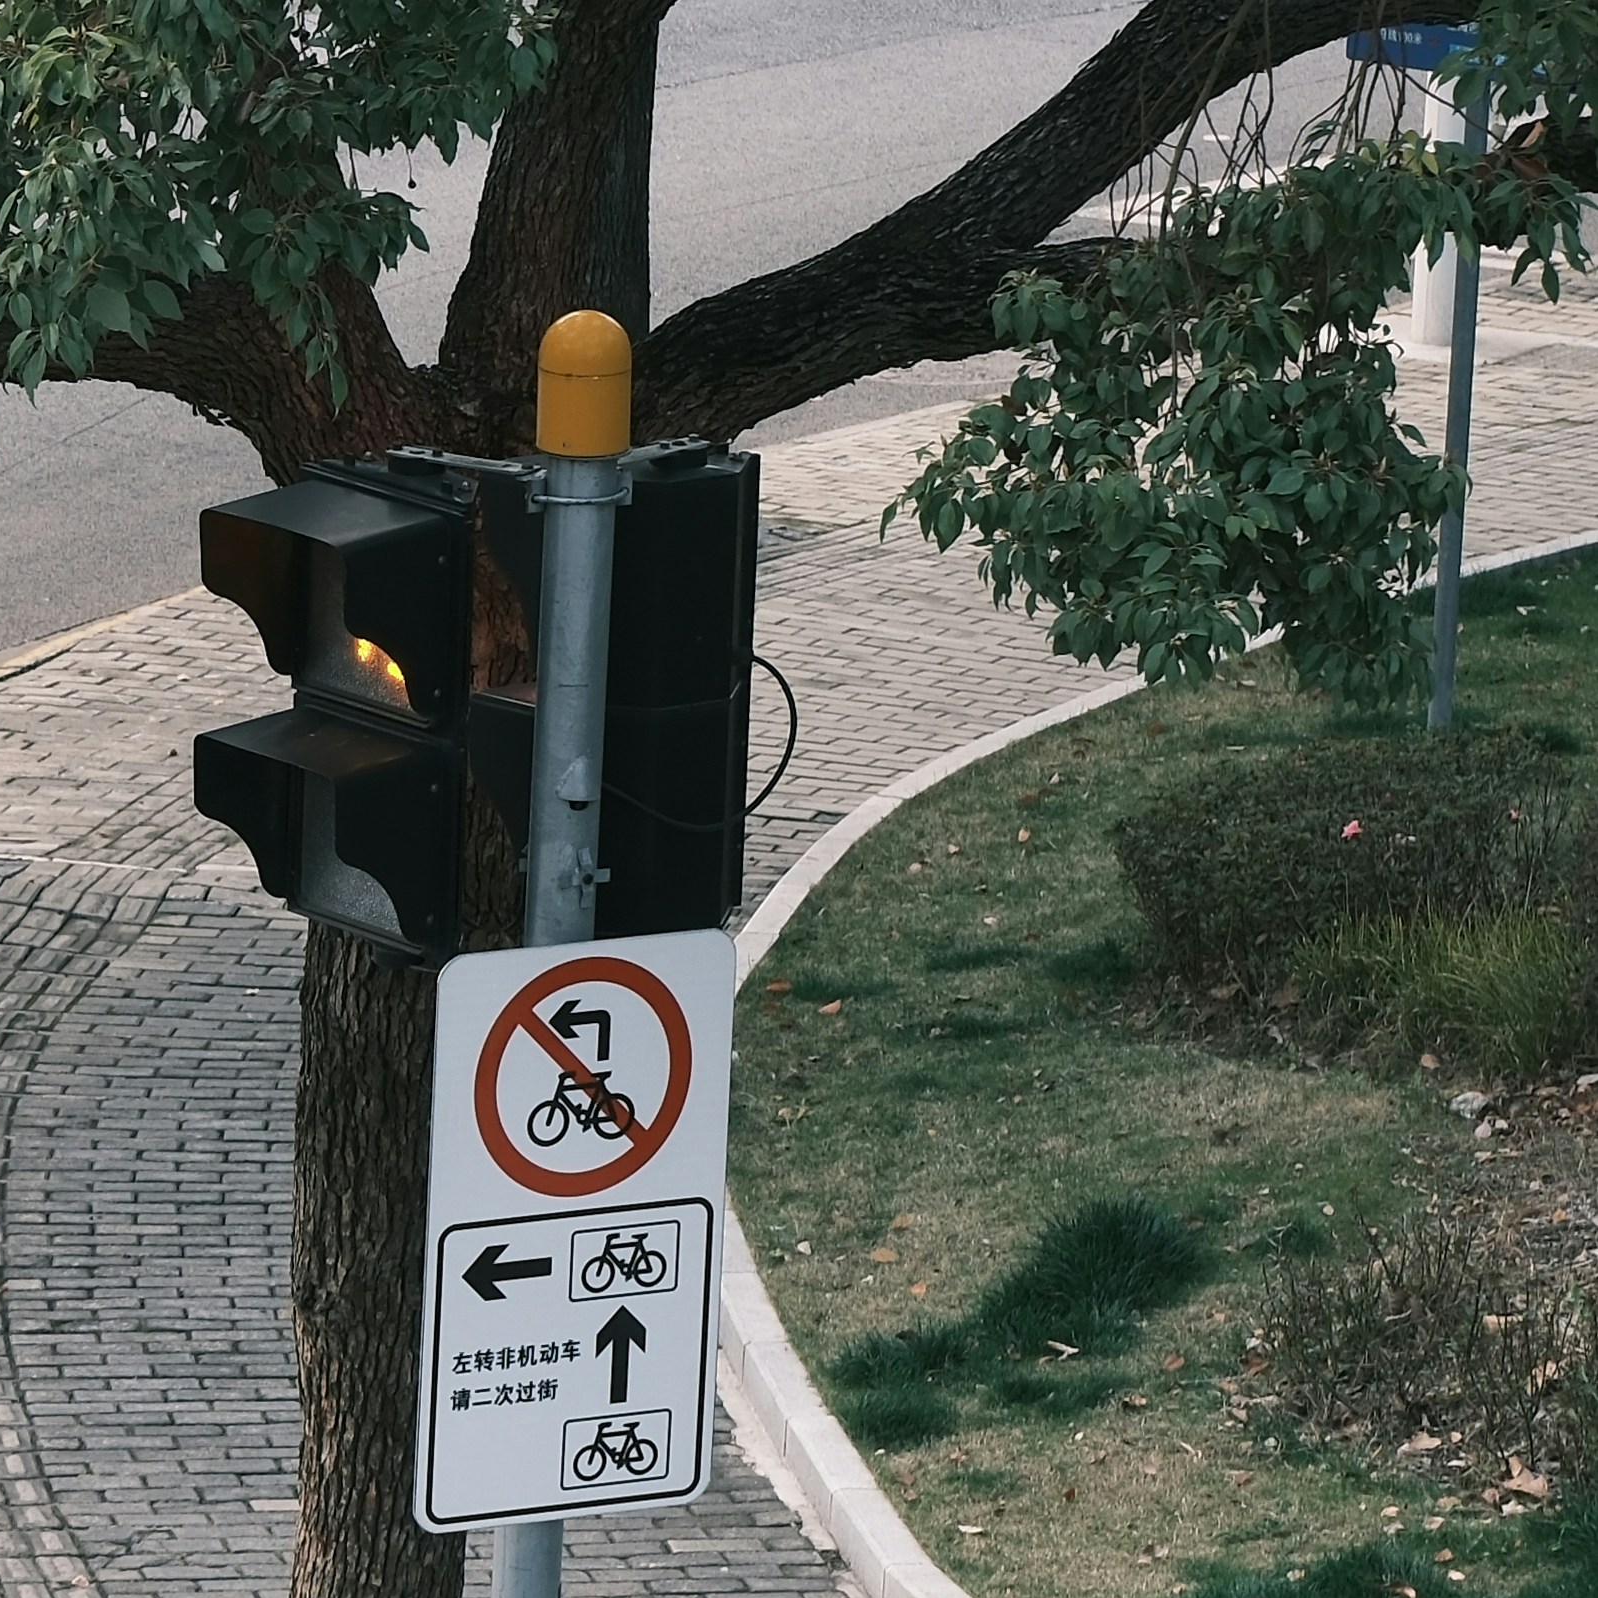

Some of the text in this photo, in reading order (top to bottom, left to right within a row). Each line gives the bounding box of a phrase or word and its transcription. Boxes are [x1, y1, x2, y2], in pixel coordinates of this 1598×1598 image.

[452, 1339, 581, 1374] 左转非机动车
[450, 1379, 559, 1411] 请二次过街
